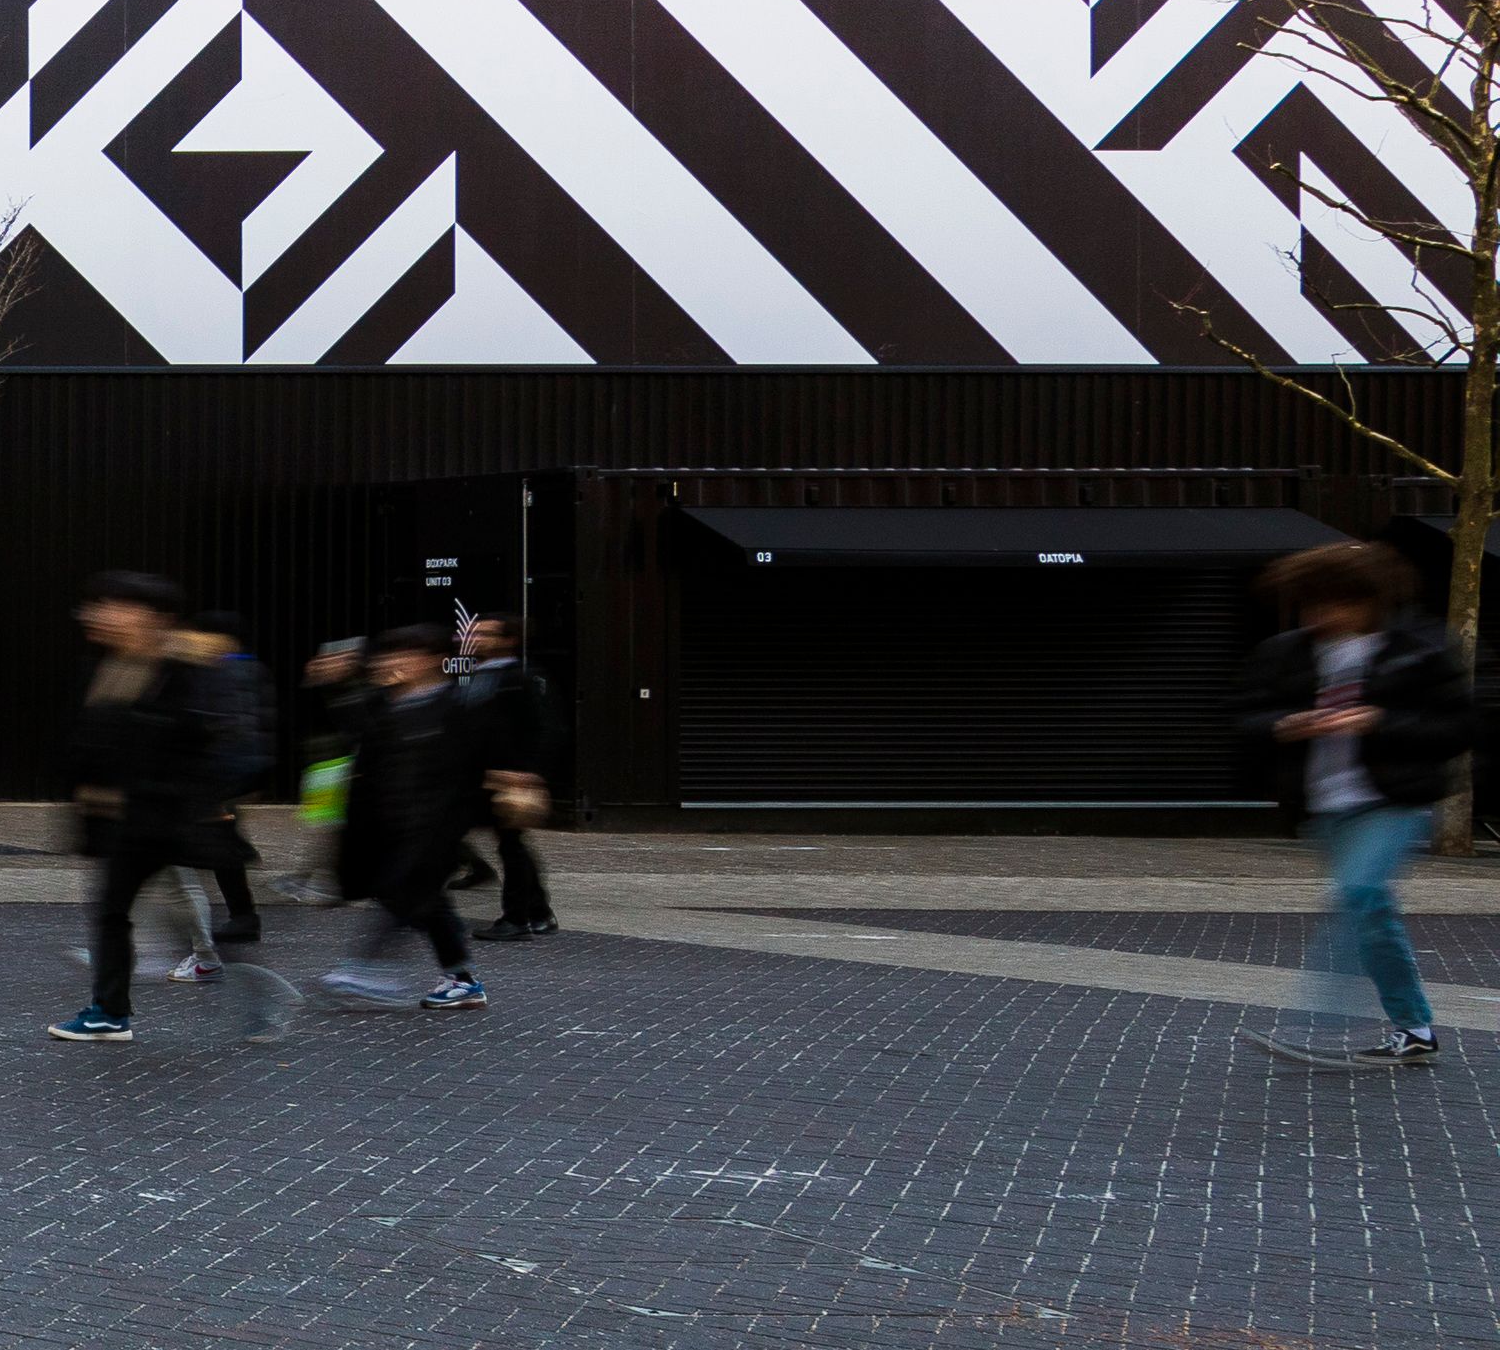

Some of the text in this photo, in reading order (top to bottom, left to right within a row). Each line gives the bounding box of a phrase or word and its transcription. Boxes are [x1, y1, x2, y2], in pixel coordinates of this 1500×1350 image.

[756, 552, 772, 562] 03
[1038, 553, 1083, 564] OATOPIA
[426, 558, 458, 568] BOXPARK
[426, 576, 452, 586] UNIT 03
